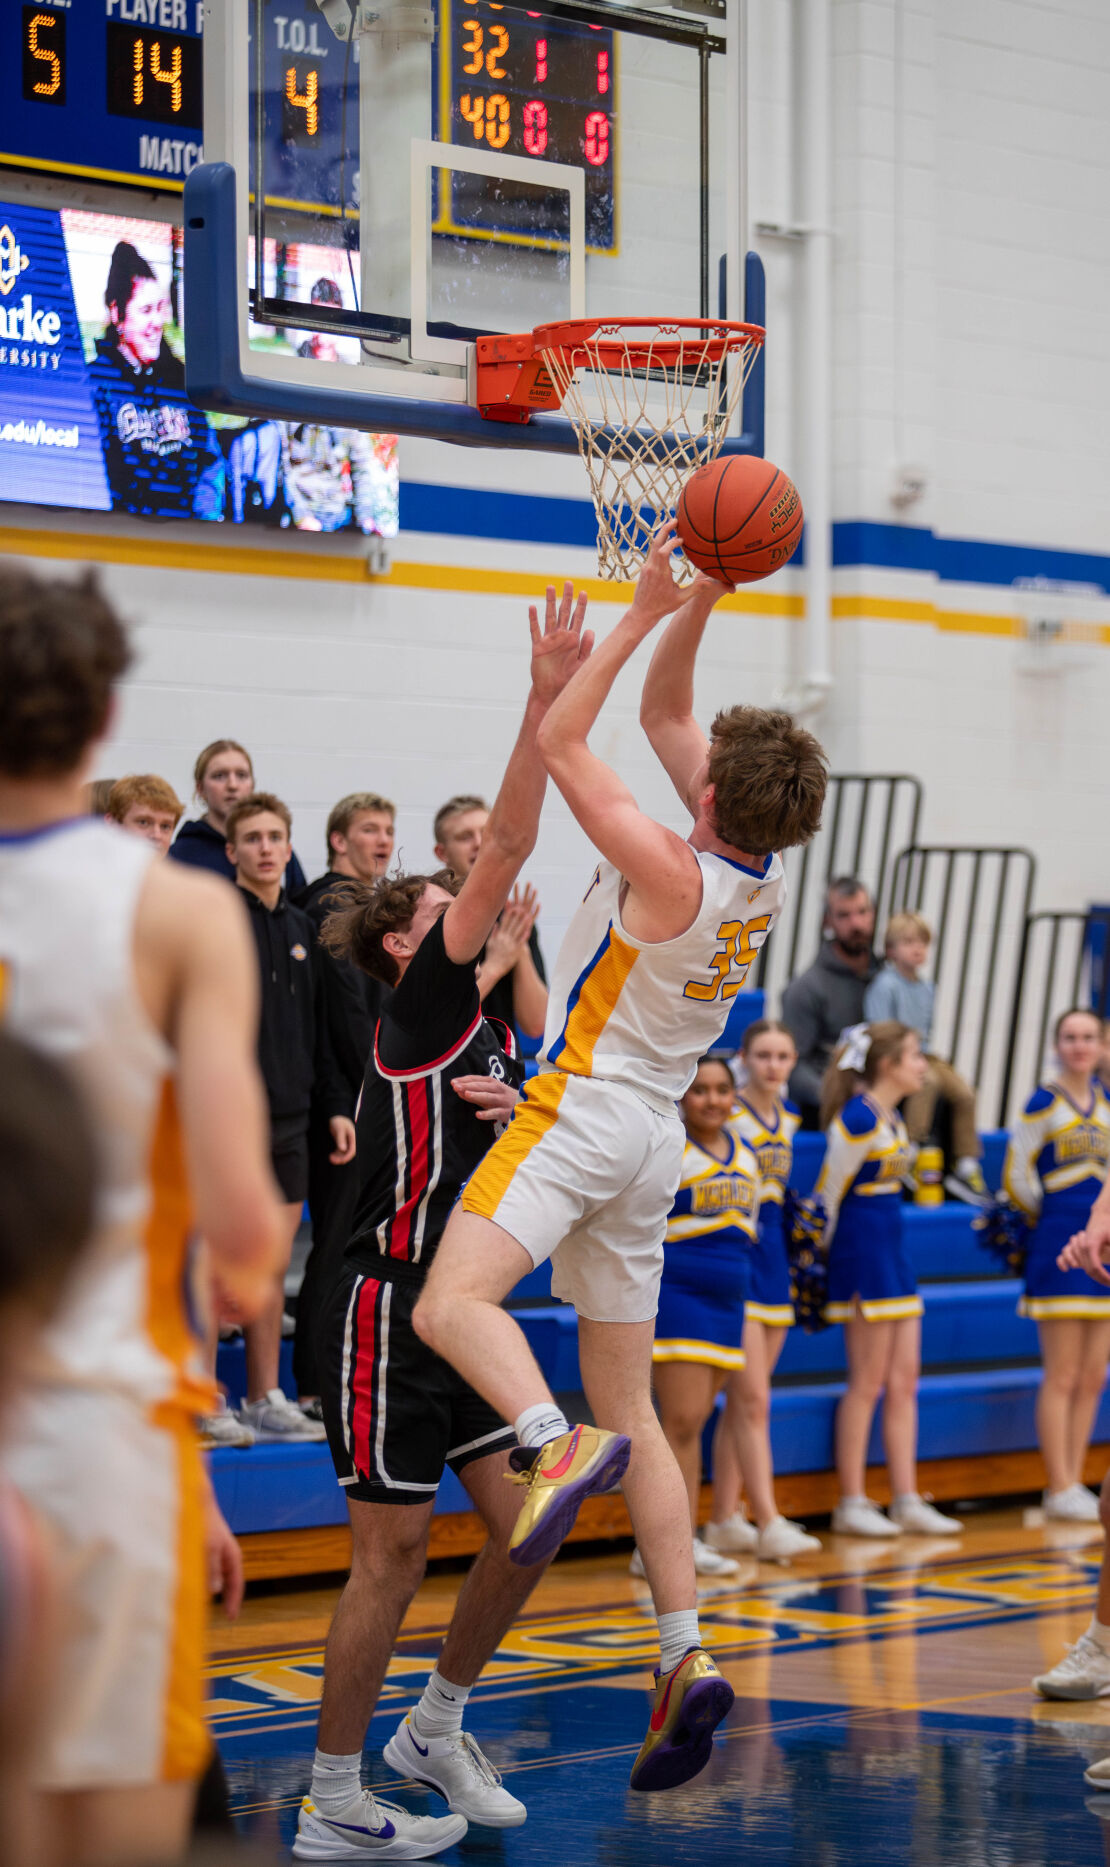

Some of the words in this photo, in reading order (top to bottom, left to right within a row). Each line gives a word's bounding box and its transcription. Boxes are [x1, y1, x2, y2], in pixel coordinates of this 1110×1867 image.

[106, 0, 188, 30] PLAYER
[273, 16, 329, 57] T.O.L.
[28, 14, 60, 95] 5
[133, 38, 182, 112] 14
[462, 20, 510, 79] 32
[535, 38, 548, 82] 1
[596, 51, 609, 94] 1
[286, 67, 318, 135] 4
[460, 94, 511, 149] 40
[523, 100, 548, 155] 0
[584, 111, 609, 166] 0
[682, 913, 773, 1001] 35
